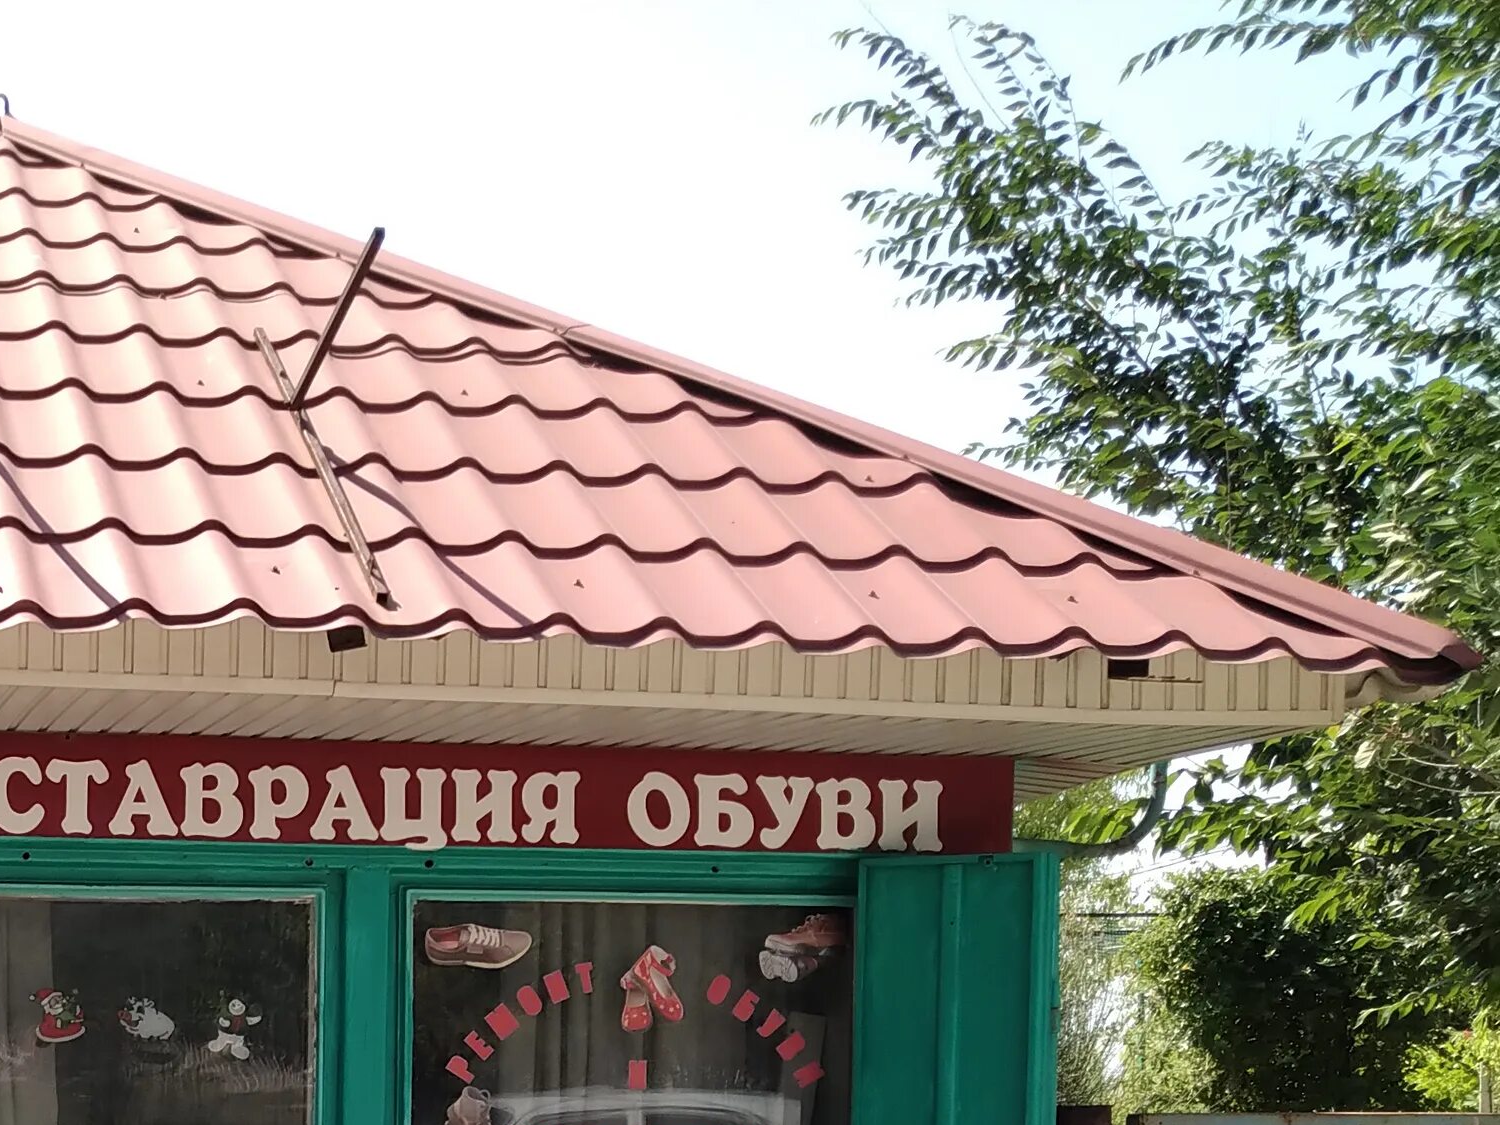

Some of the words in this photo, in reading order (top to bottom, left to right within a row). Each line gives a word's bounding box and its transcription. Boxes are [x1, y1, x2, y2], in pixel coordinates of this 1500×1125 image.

[626, 770, 944, 853] ОБУВИ
[445, 961, 594, 1084] РЕМОНТ
[706, 974, 826, 1088] ОБУВИ
[628, 1059, 648, 1090] И
